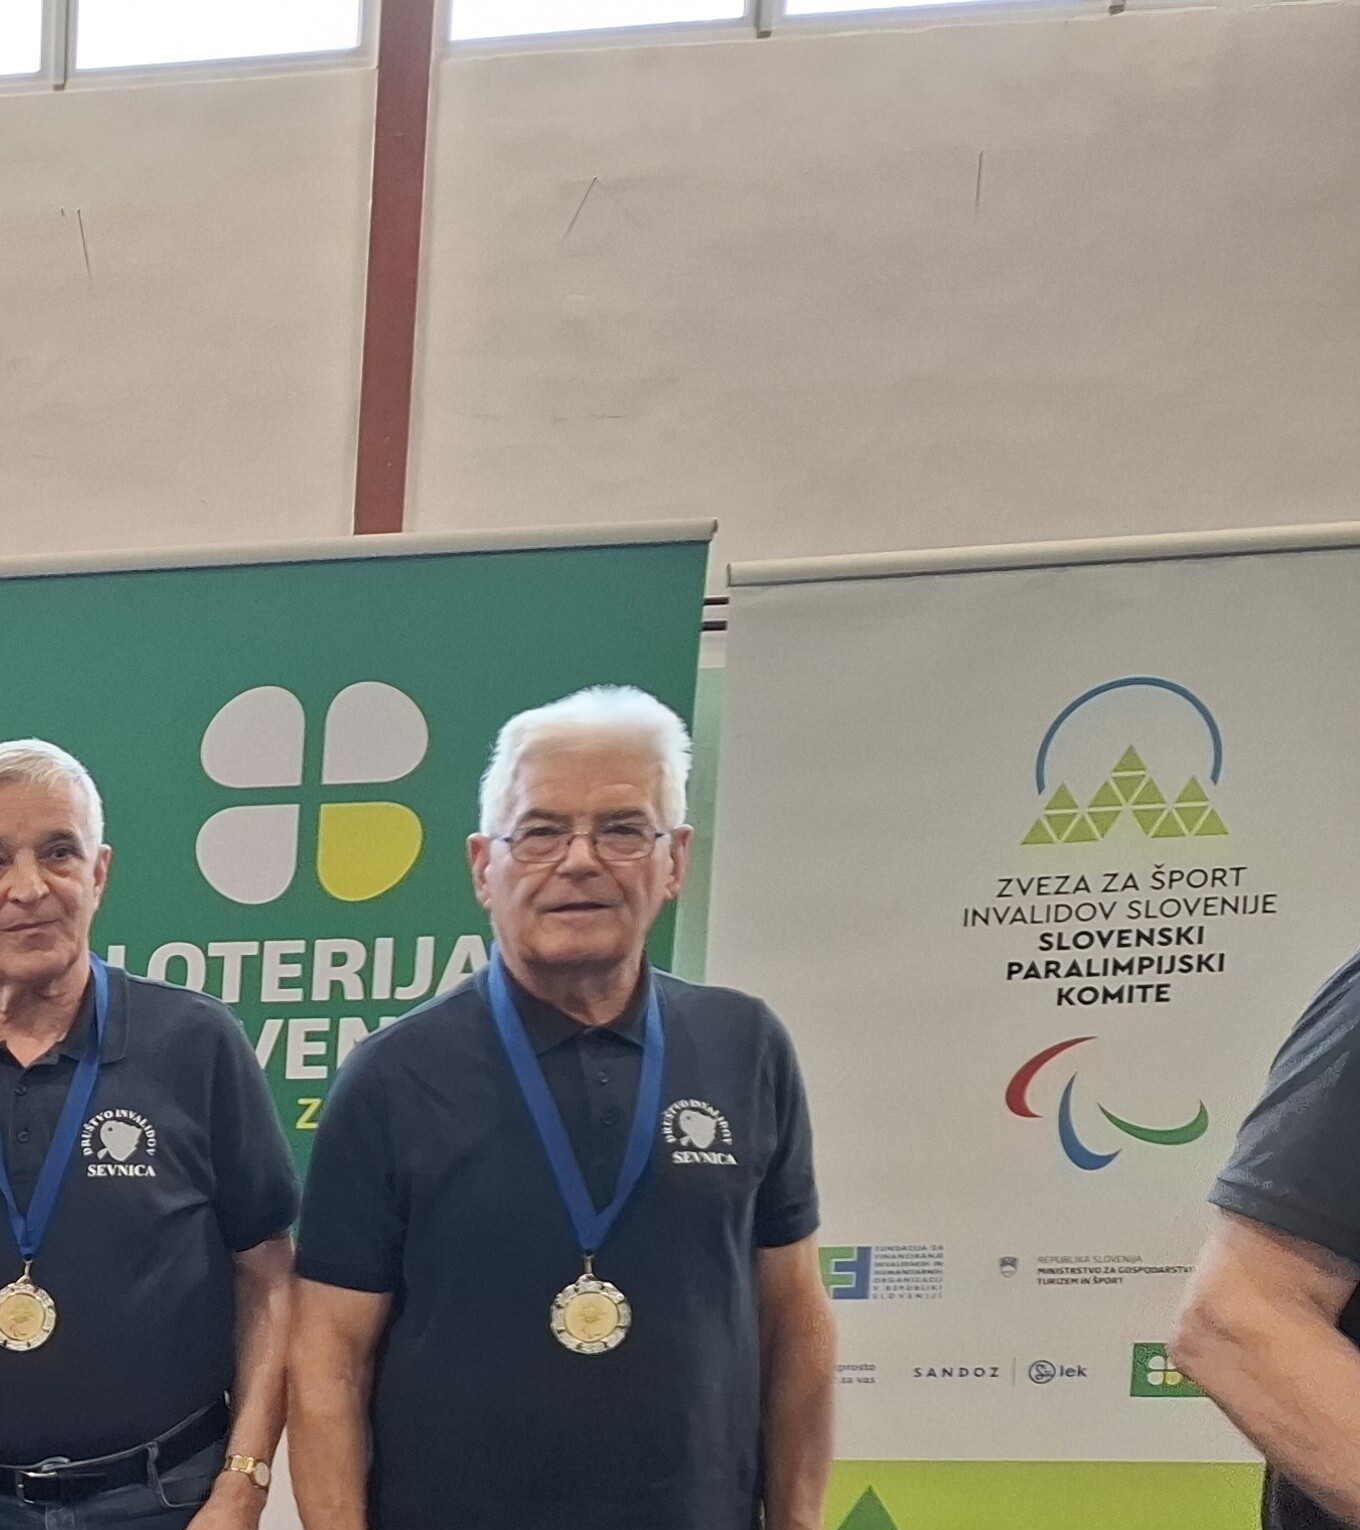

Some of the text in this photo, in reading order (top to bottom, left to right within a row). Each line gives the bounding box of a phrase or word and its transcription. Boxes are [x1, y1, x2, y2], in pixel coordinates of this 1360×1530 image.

[997, 864, 1247, 898] ZVEZA ZA ŠPORT
[963, 894, 1277, 927] INVALIDOV SLOVENIJE
[1038, 926, 1205, 951] SLOVENSKI
[1006, 953, 1225, 980] PARALIMPIJSKI
[1057, 983, 1171, 1006] KOMITE
[671, 1151, 739, 1166] SEVNICA
[87, 1164, 156, 1177] SEVNICA
[1037, 1267, 1101, 1275] MINISTRSTVO
[1104, 1266, 1116, 1274] ZA
[1037, 1277, 1079, 1285] TURIZEM
[1093, 1275, 1123, 1284] ŠPORT
[913, 1366, 1000, 1378] SANDOZ
[1059, 1364, 1088, 1378] lek
